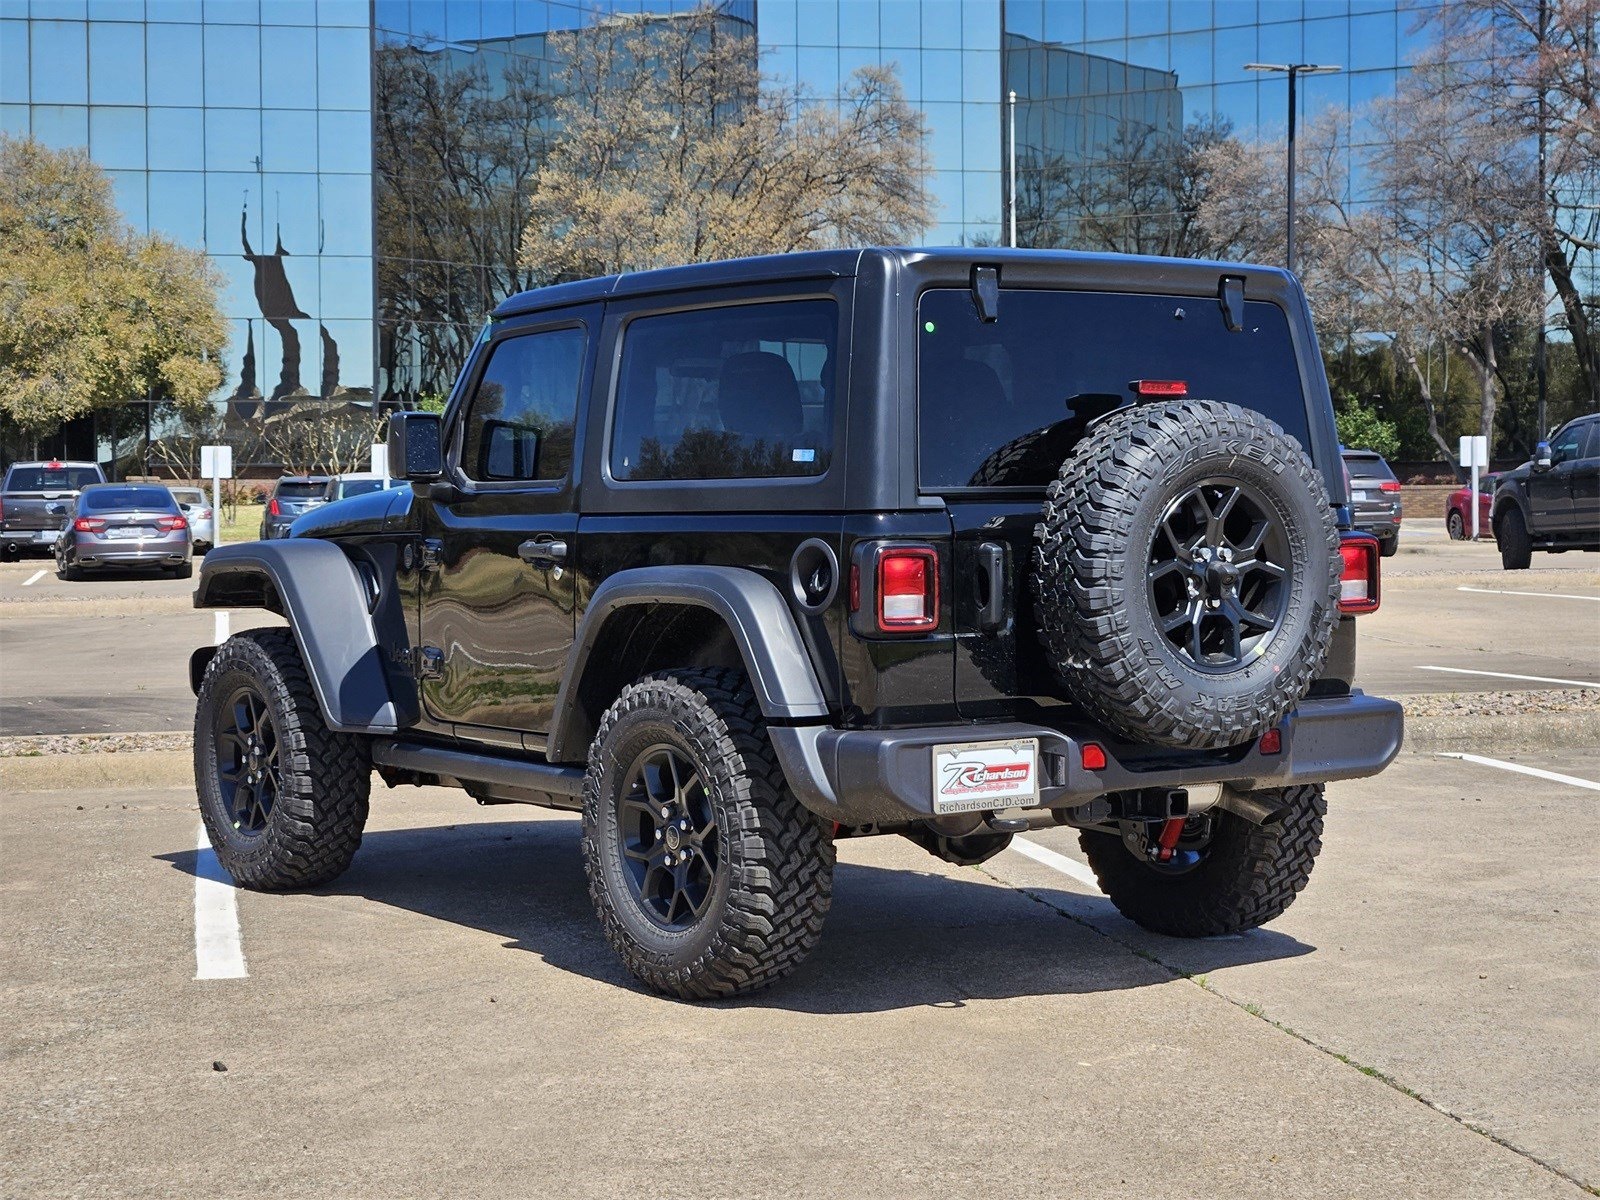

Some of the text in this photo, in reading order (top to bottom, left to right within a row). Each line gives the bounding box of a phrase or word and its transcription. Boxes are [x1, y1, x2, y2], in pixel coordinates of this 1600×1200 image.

[1159, 438, 1286, 486] FALKEN
[941, 761, 1027, 794] Richardson
[939, 797, 1035, 813] RichardsonCJD.com
